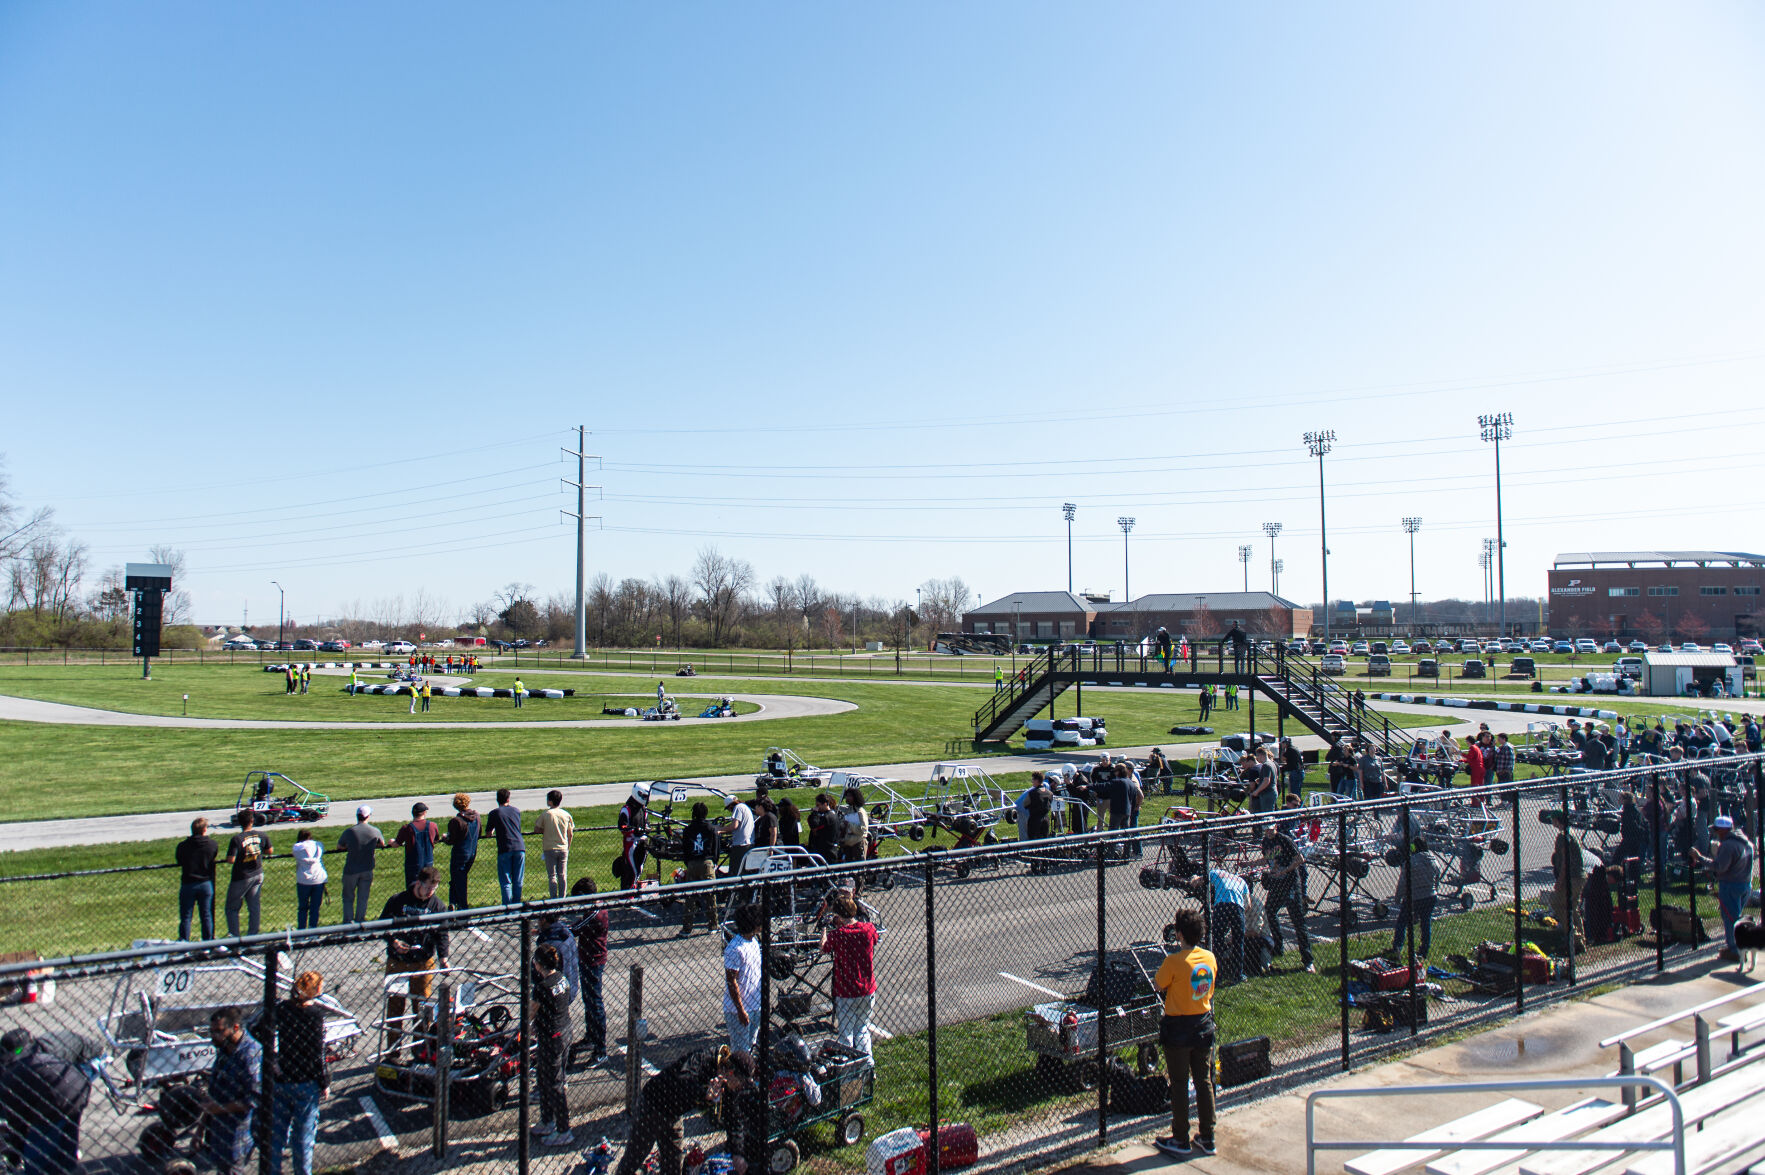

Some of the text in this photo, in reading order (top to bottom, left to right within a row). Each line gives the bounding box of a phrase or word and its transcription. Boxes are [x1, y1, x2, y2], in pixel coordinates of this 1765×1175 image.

[136, 607, 142, 615] 2
[136, 620, 142, 628] 3
[135, 633, 141, 641] 4
[135, 646, 141, 654] 5
[847, 776, 860, 788] 86
[674, 788, 687, 801] 75
[256, 802, 266, 810] 27
[163, 970, 189, 993] 90
